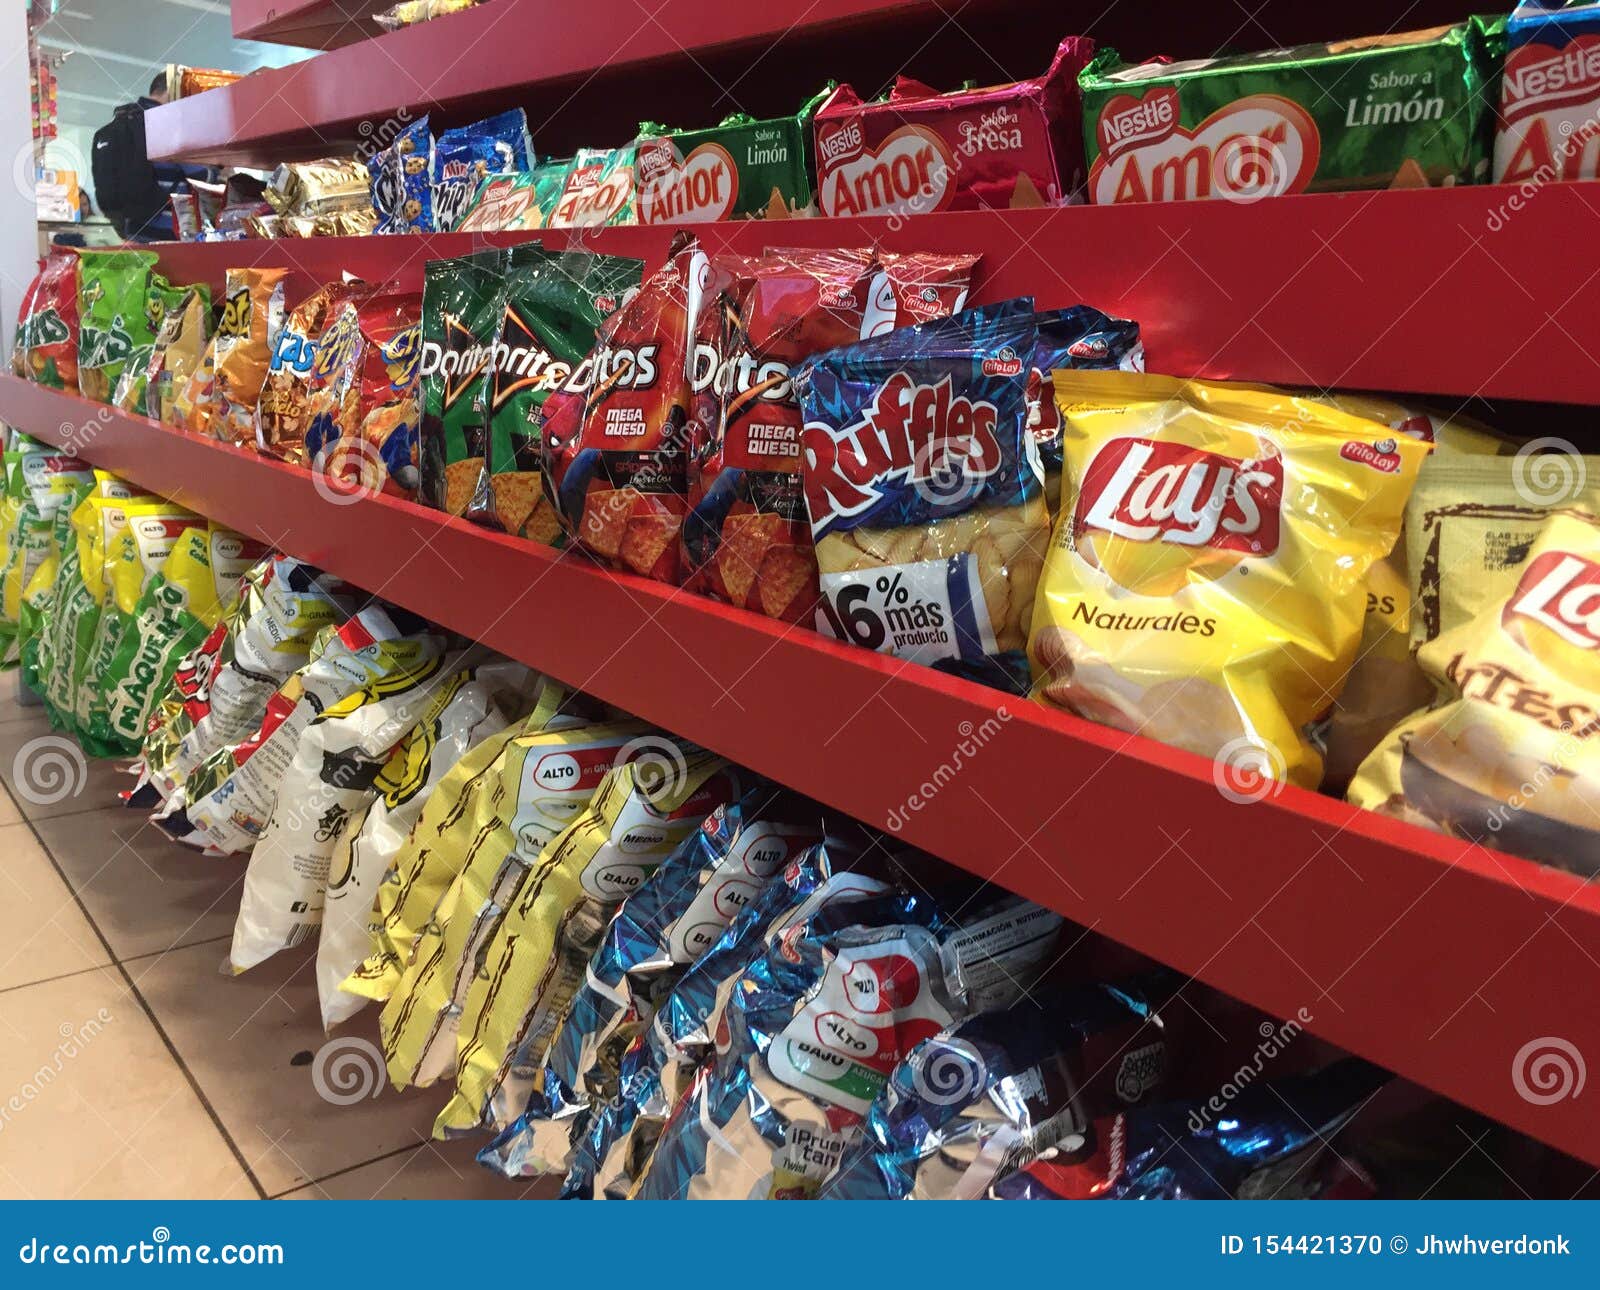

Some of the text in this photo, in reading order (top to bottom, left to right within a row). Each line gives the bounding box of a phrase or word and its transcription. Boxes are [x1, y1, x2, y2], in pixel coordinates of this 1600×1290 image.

[1369, 72, 1432, 90] Sabor a
[1103, 95, 1173, 144] Nestlé
[1345, 95, 1444, 128] Limón
[754, 130, 775, 142] Sabor
[820, 122, 861, 161] Nestlé
[966, 127, 1023, 152] Fresa
[640, 139, 673, 172] Nestlé
[747, 142, 788, 165] Limón
[1111, 120, 1288, 203] Amor
[648, 162, 723, 224] Amor
[834, 144, 936, 217] Amor
[605, 422, 647, 436] QUESO
[606, 408, 643, 422] MEGA
[748, 424, 796, 441] MEGA
[747, 440, 800, 457] QUESO
[803, 373, 1001, 533] Ruffles
[1346, 442, 1395, 471] Frito Lay
[1083, 441, 1277, 546] Lay's
[887, 597, 944, 633] más
[1072, 602, 1217, 638] Naturales
[894, 629, 949, 651] producto
[542, 768, 574, 778] ALTO
[752, 851, 780, 862] ALTO
[602, 872, 639, 887] BAJO
[827, 1022, 867, 1051] ALTO
